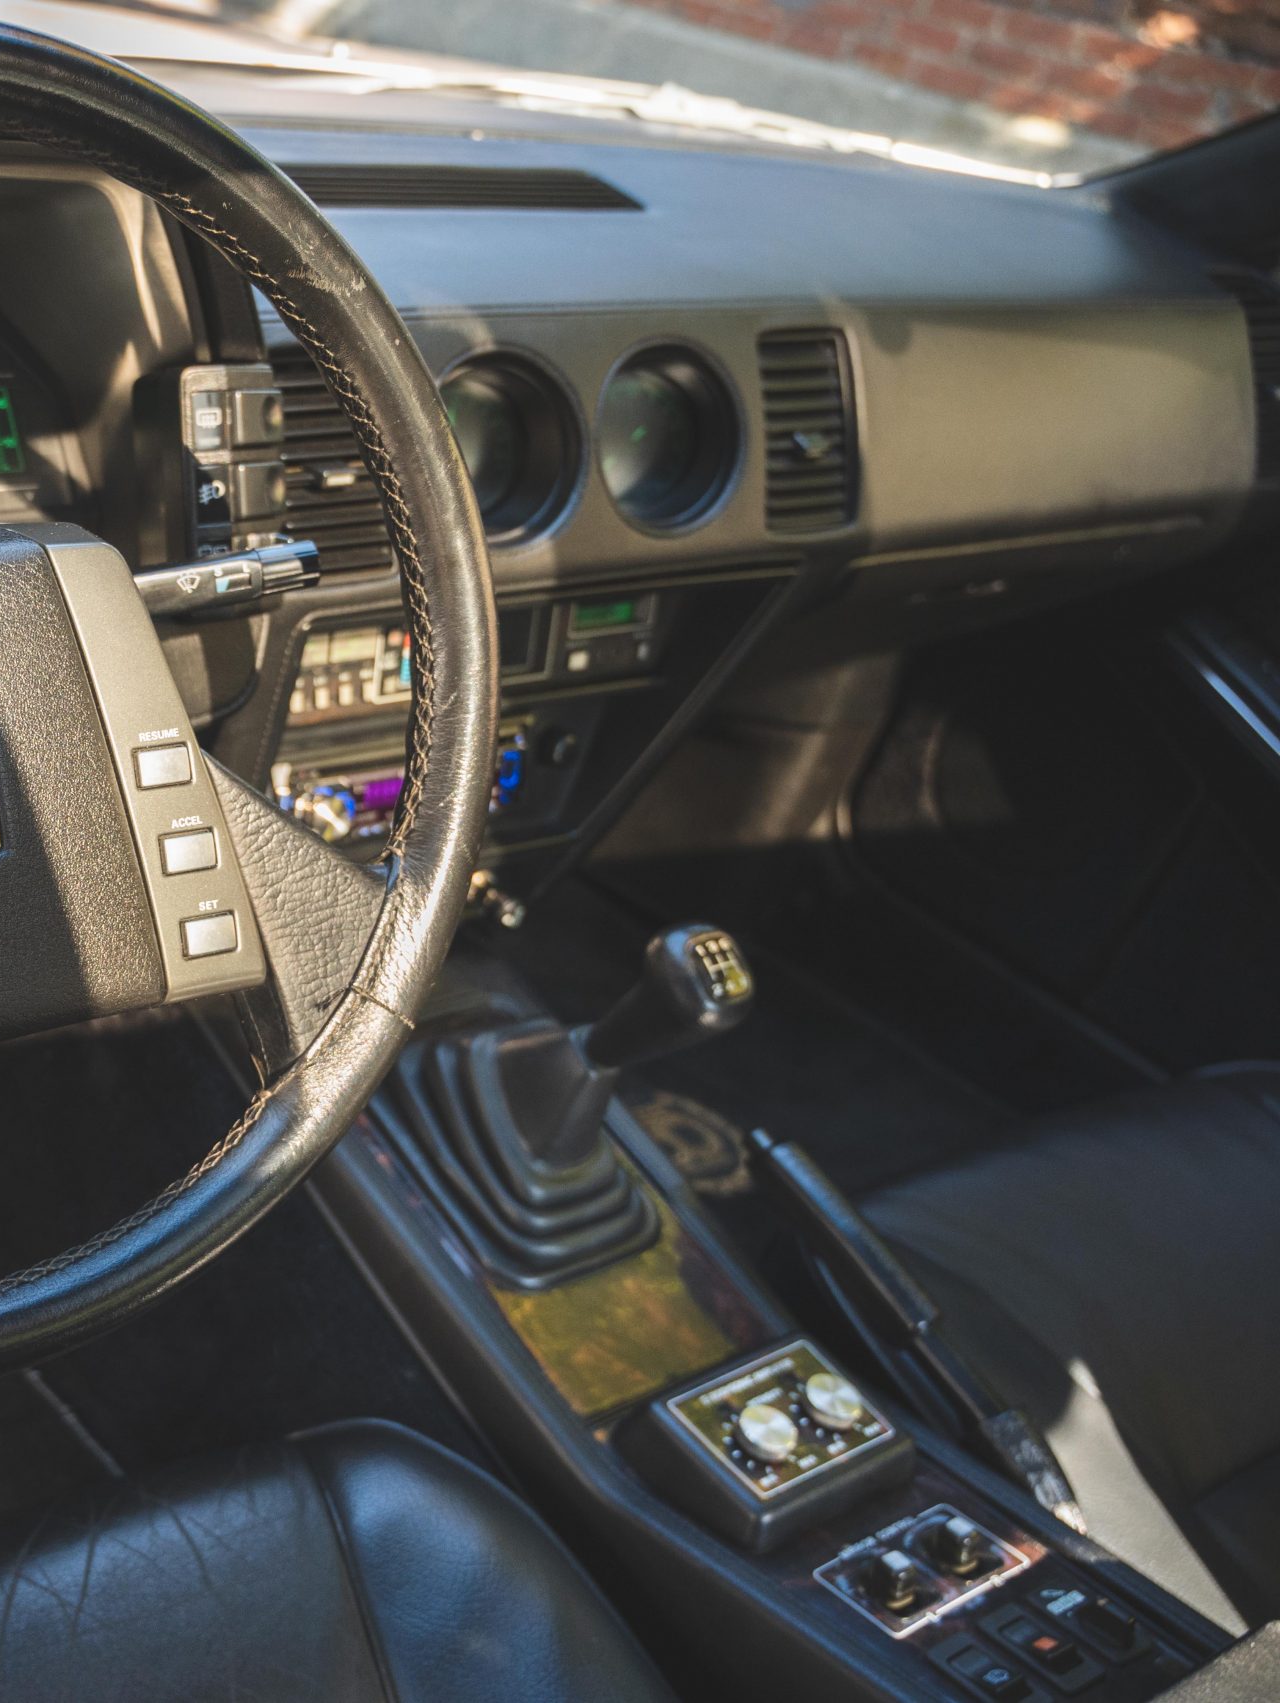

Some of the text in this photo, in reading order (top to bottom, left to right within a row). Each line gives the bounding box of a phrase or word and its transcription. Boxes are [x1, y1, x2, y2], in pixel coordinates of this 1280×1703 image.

[138, 727, 180, 742] RESUME
[171, 815, 204, 829] ACCEL
[198, 900, 218, 911] SET
